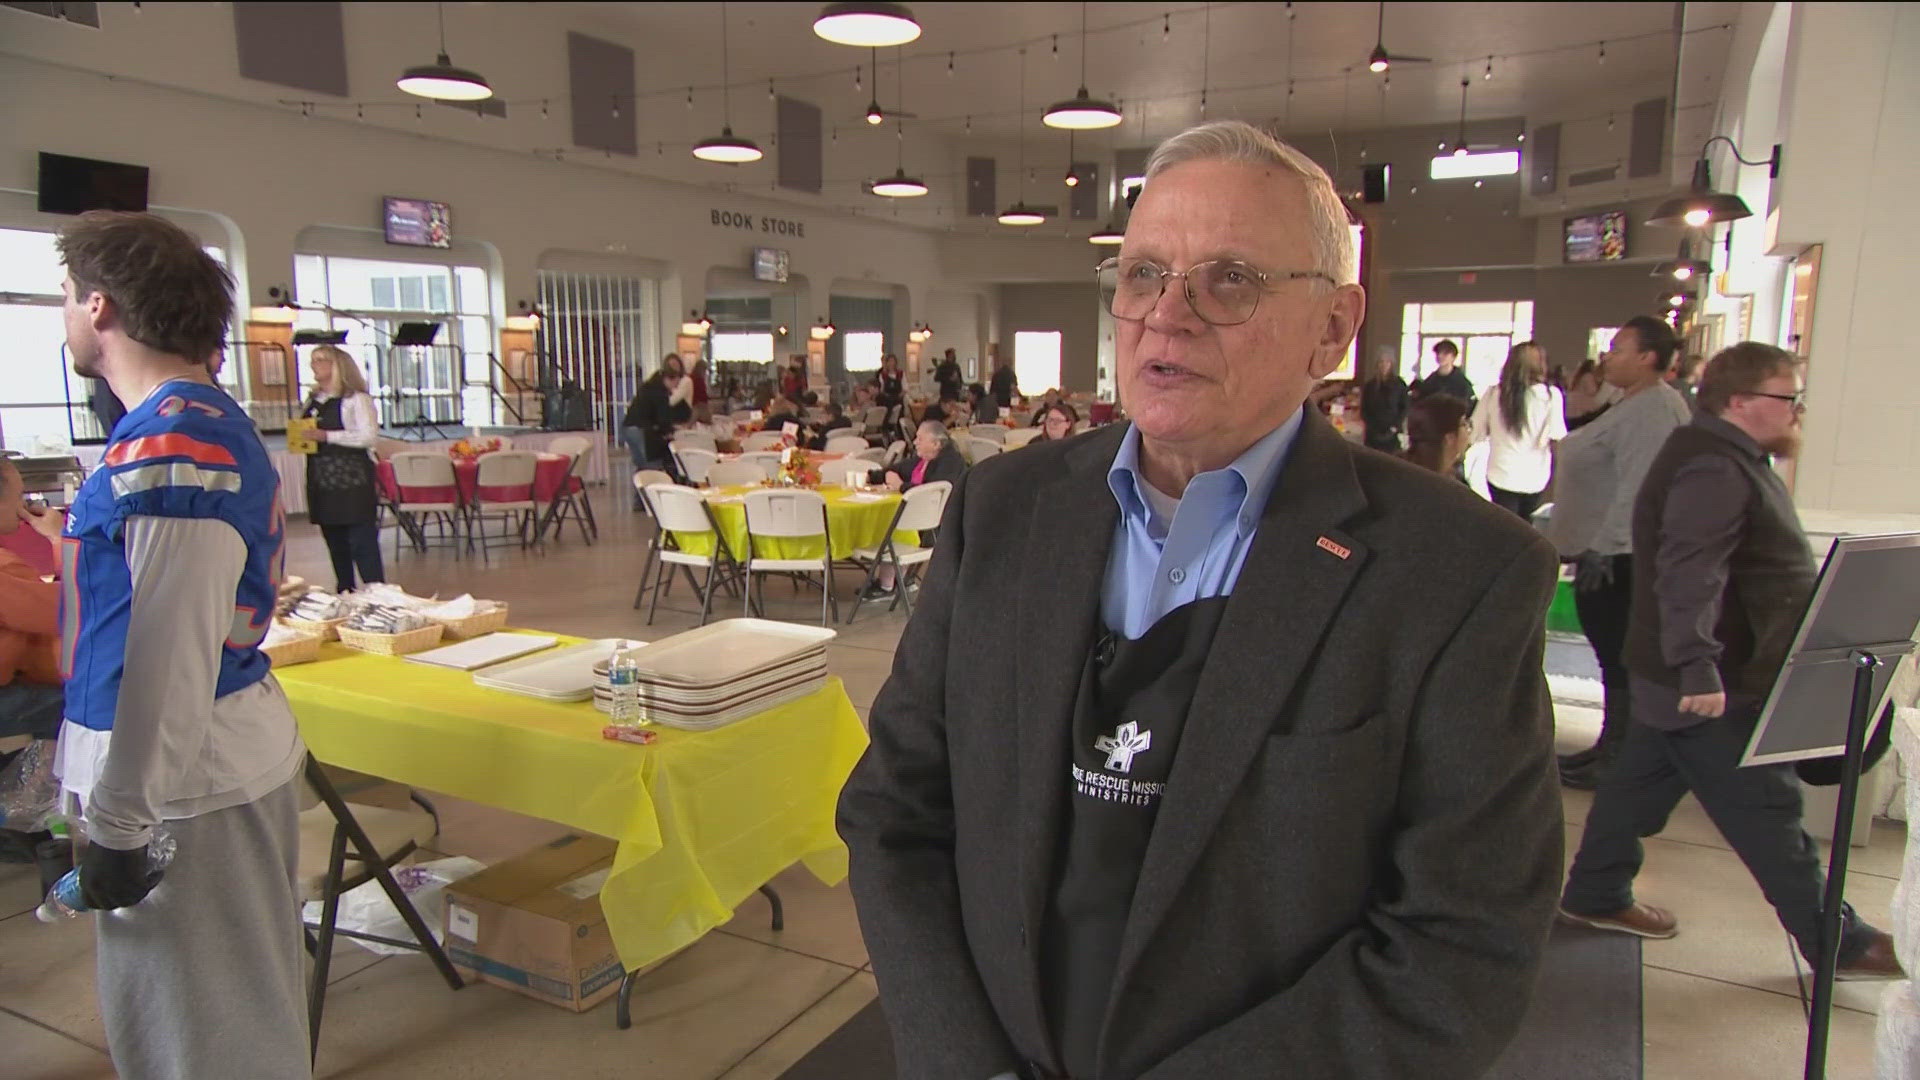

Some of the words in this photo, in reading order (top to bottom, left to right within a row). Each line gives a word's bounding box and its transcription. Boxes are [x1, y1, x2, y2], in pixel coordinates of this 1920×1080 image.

[711, 209, 752, 229] BOOK
[761, 217, 804, 237] STORE
[1077, 782, 1150, 806] MINISTRIES
[1085, 772, 1129, 792] RESCUE
[1132, 781, 1166, 795] MISSIO
